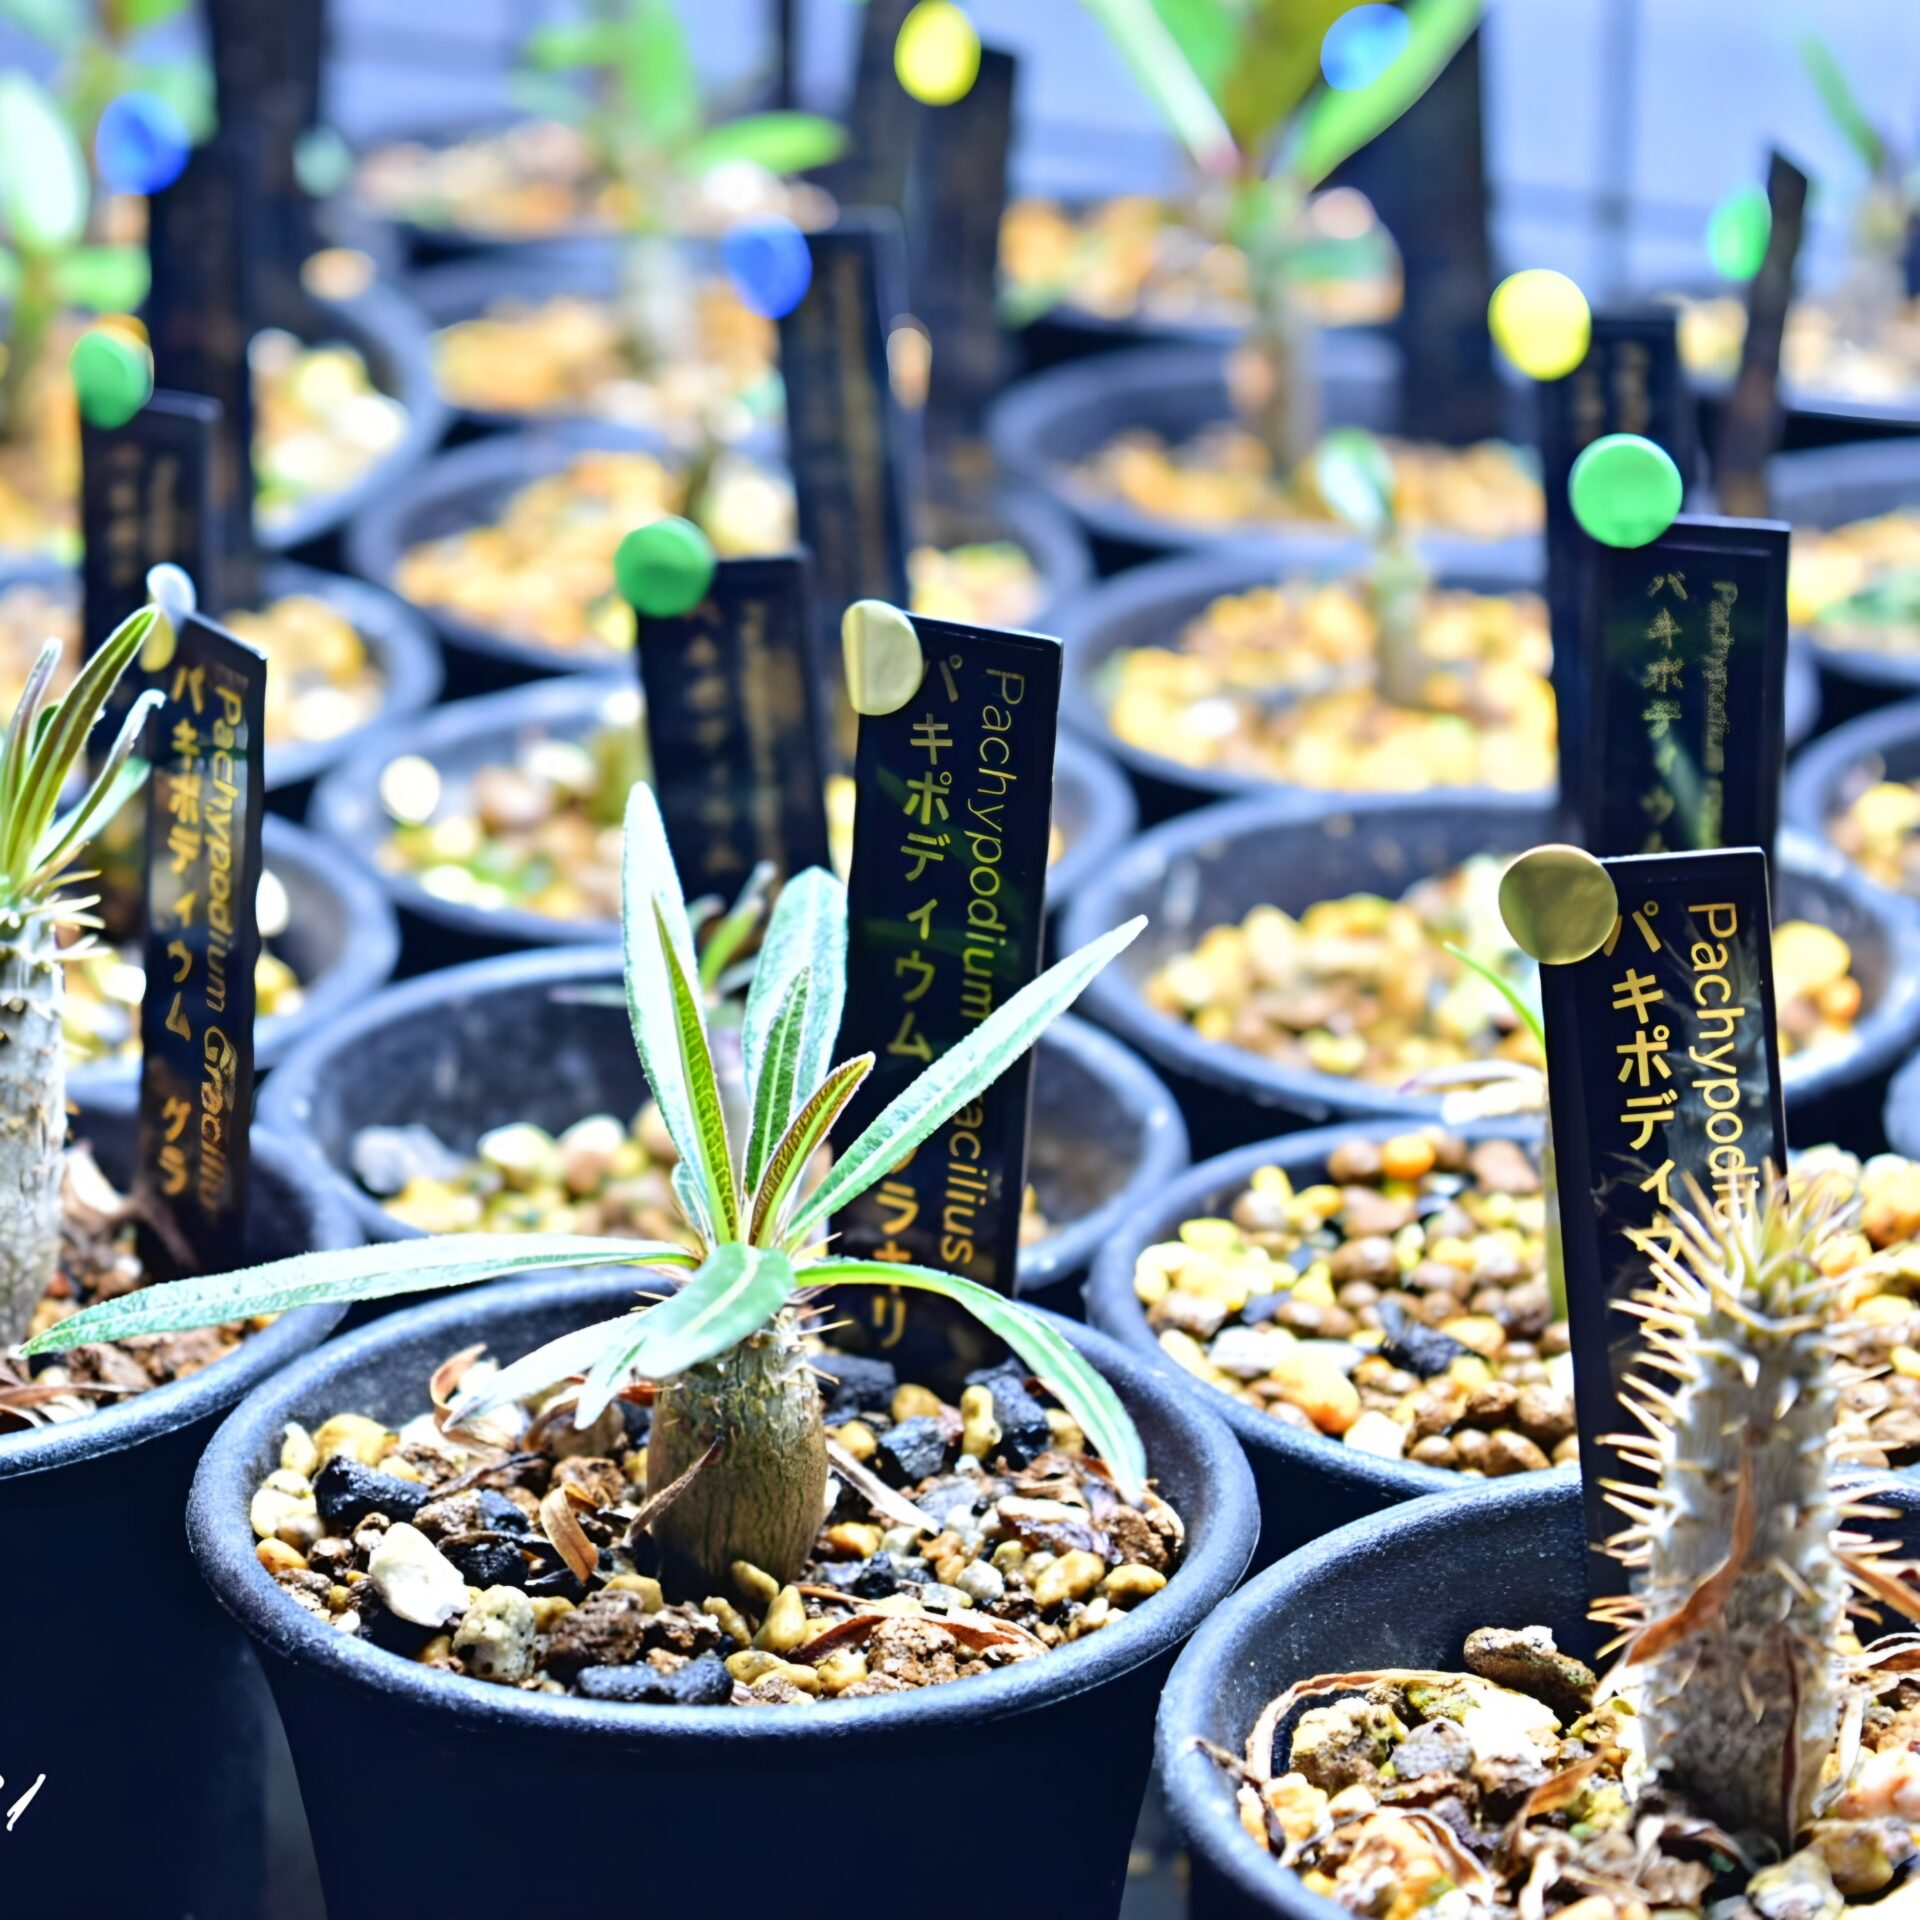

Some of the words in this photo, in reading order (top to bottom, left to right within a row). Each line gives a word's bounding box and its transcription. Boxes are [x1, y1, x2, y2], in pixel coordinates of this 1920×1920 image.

[204, 685, 242, 1013] Pachypodium
[887, 654, 963, 1062] パキポディウム
[960, 667, 1025, 1021] Pachypodium
[872, 1147, 919, 1347] ラキリ
[940, 1092, 989, 1265] acilius
[1603, 900, 1682, 1335] パキポディウ
